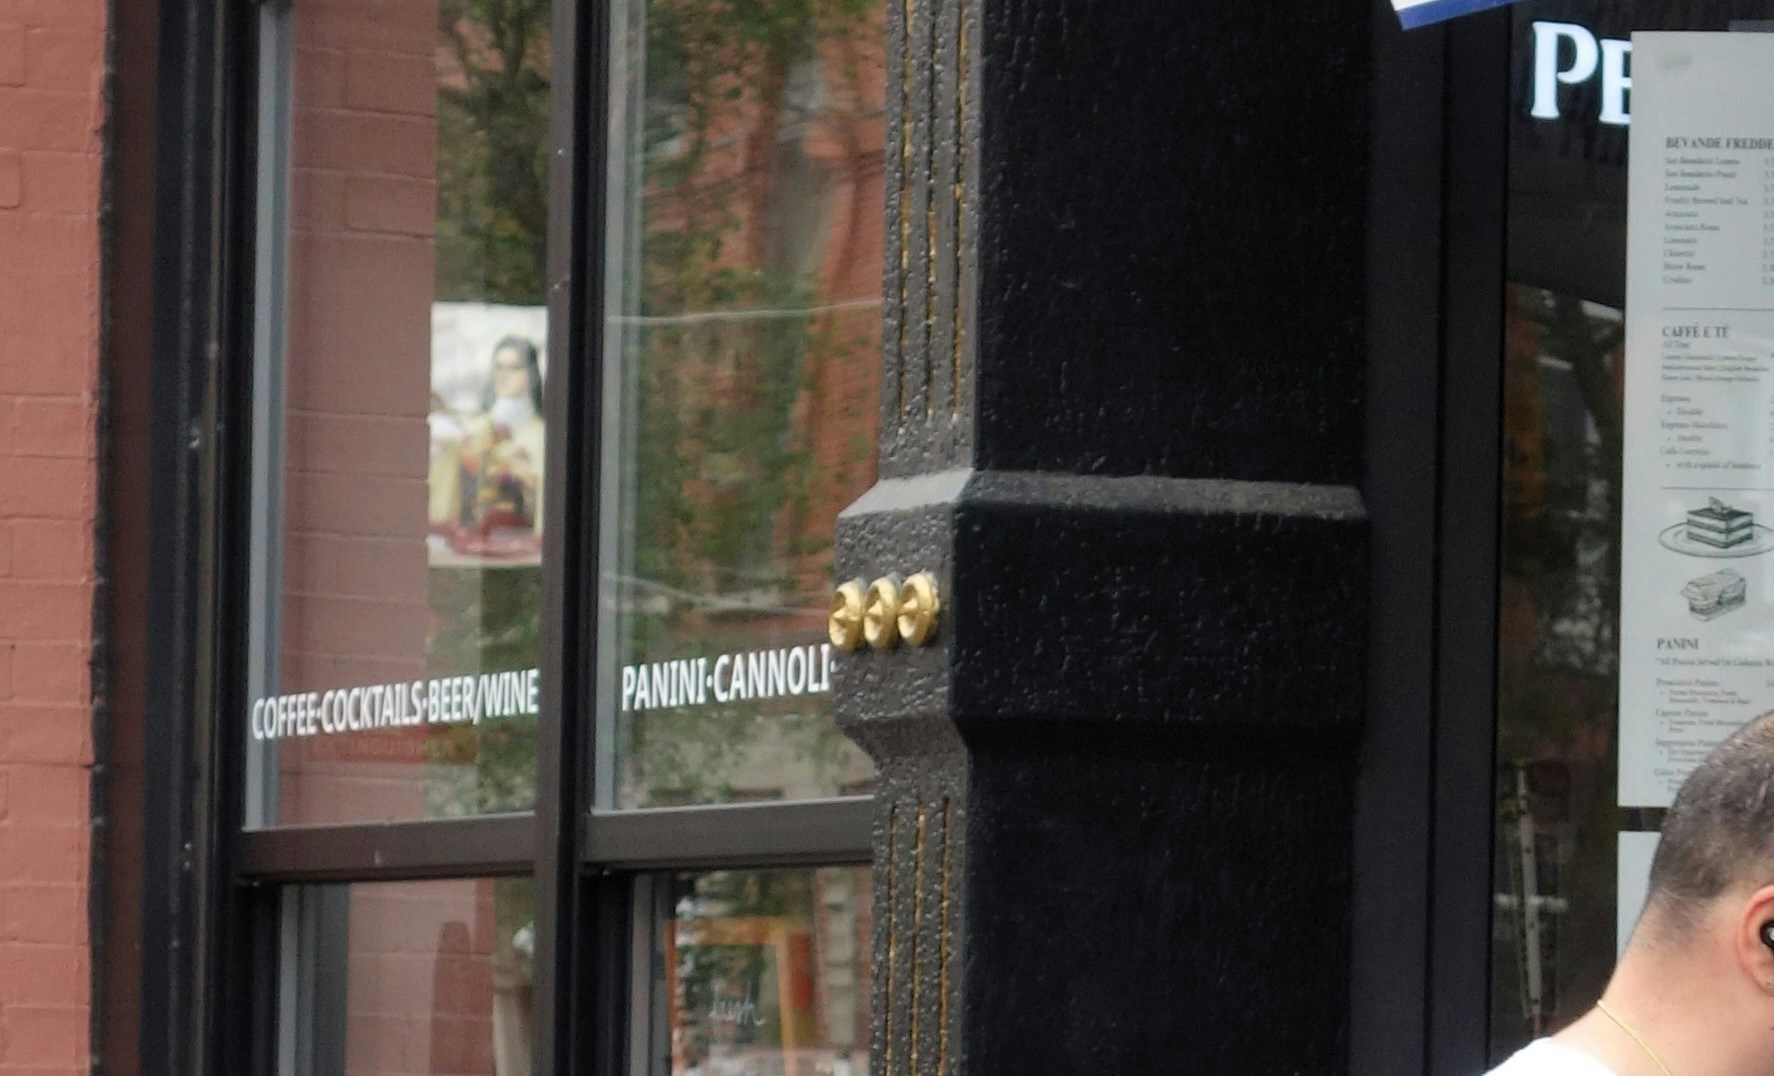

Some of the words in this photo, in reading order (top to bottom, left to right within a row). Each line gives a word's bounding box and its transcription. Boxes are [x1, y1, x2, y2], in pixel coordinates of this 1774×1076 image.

[1665, 137, 1722, 149] BEVANDE
[1662, 322, 1700, 338] CAFFÉ
[1656, 638, 1699, 650] PANINI
